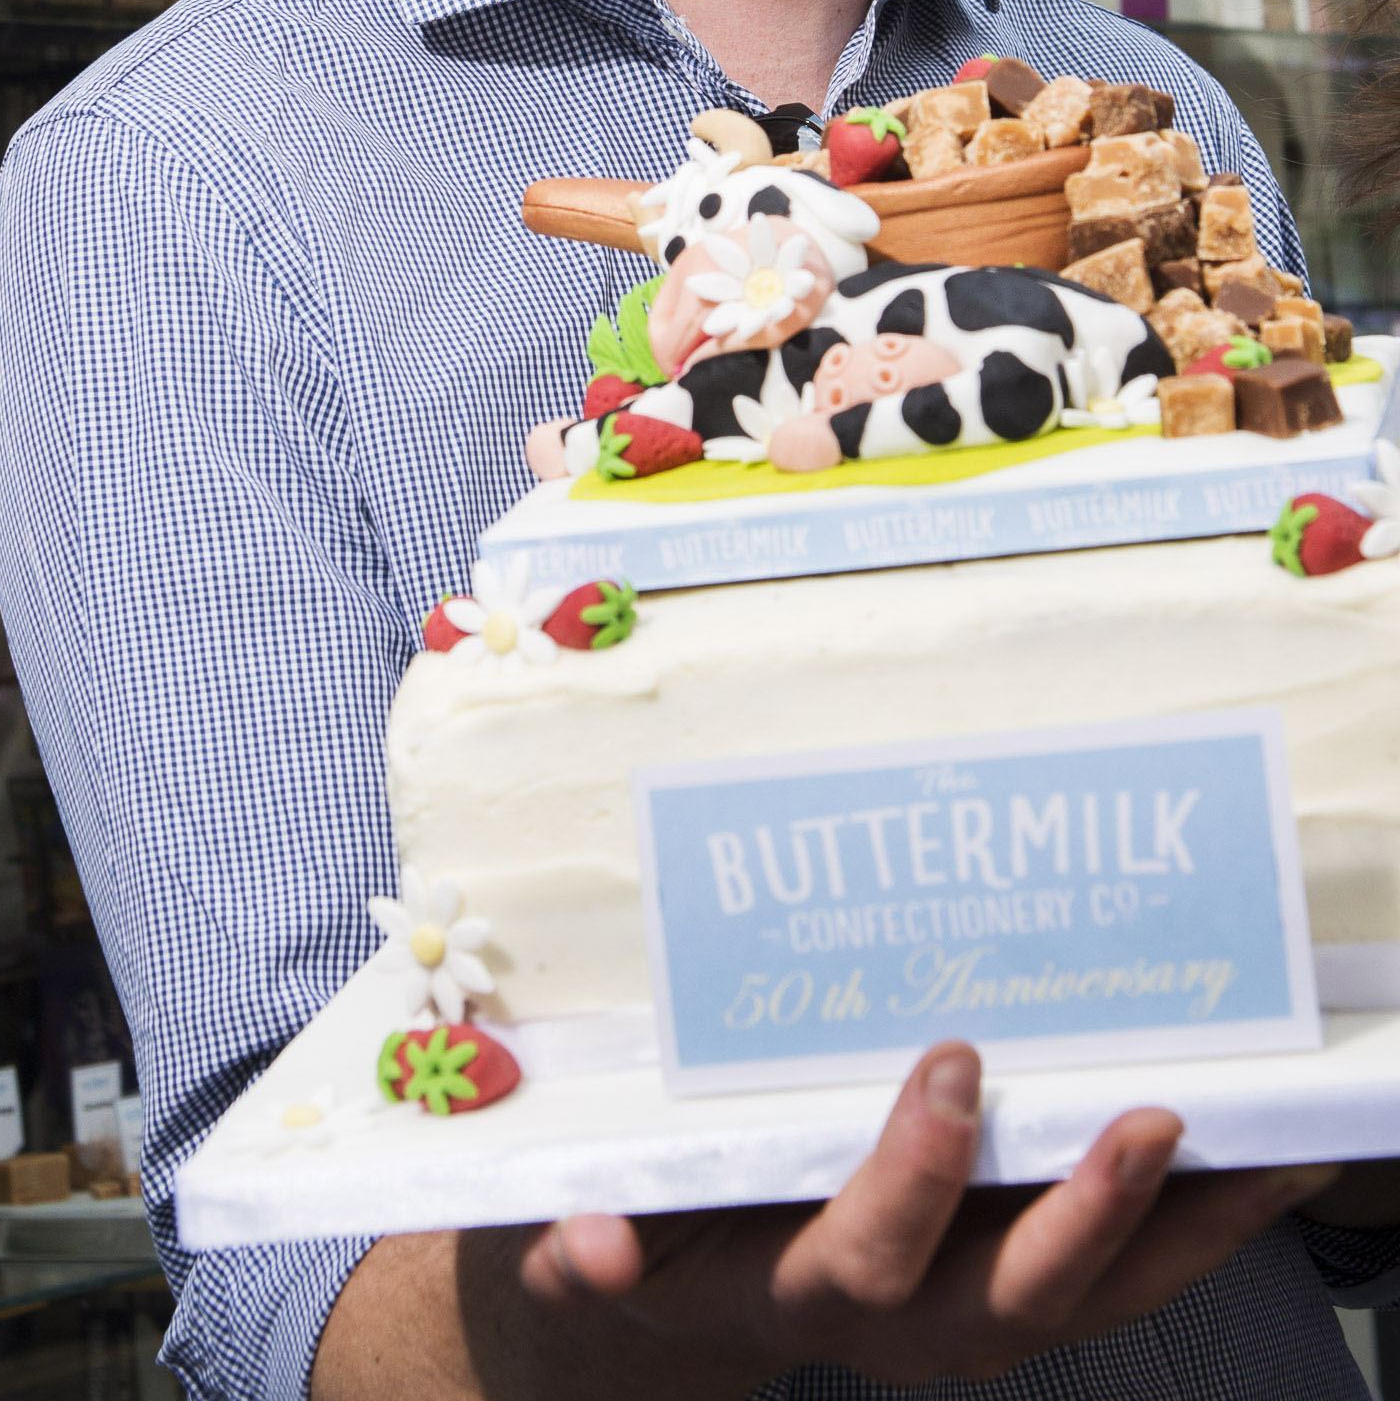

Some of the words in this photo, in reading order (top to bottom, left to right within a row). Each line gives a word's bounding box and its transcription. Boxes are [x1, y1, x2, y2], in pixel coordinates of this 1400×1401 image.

[659, 524, 811, 570] BUTTERMILK
[843, 505, 997, 552] BUTTERMILK
[1026, 486, 1183, 534] BUTTERMILK
[914, 762, 980, 796] The
[707, 789, 1200, 915] BUTTERMILK
[789, 888, 1076, 954] CONFECTIONERY
[886, 942, 1237, 1021] Anniversary
